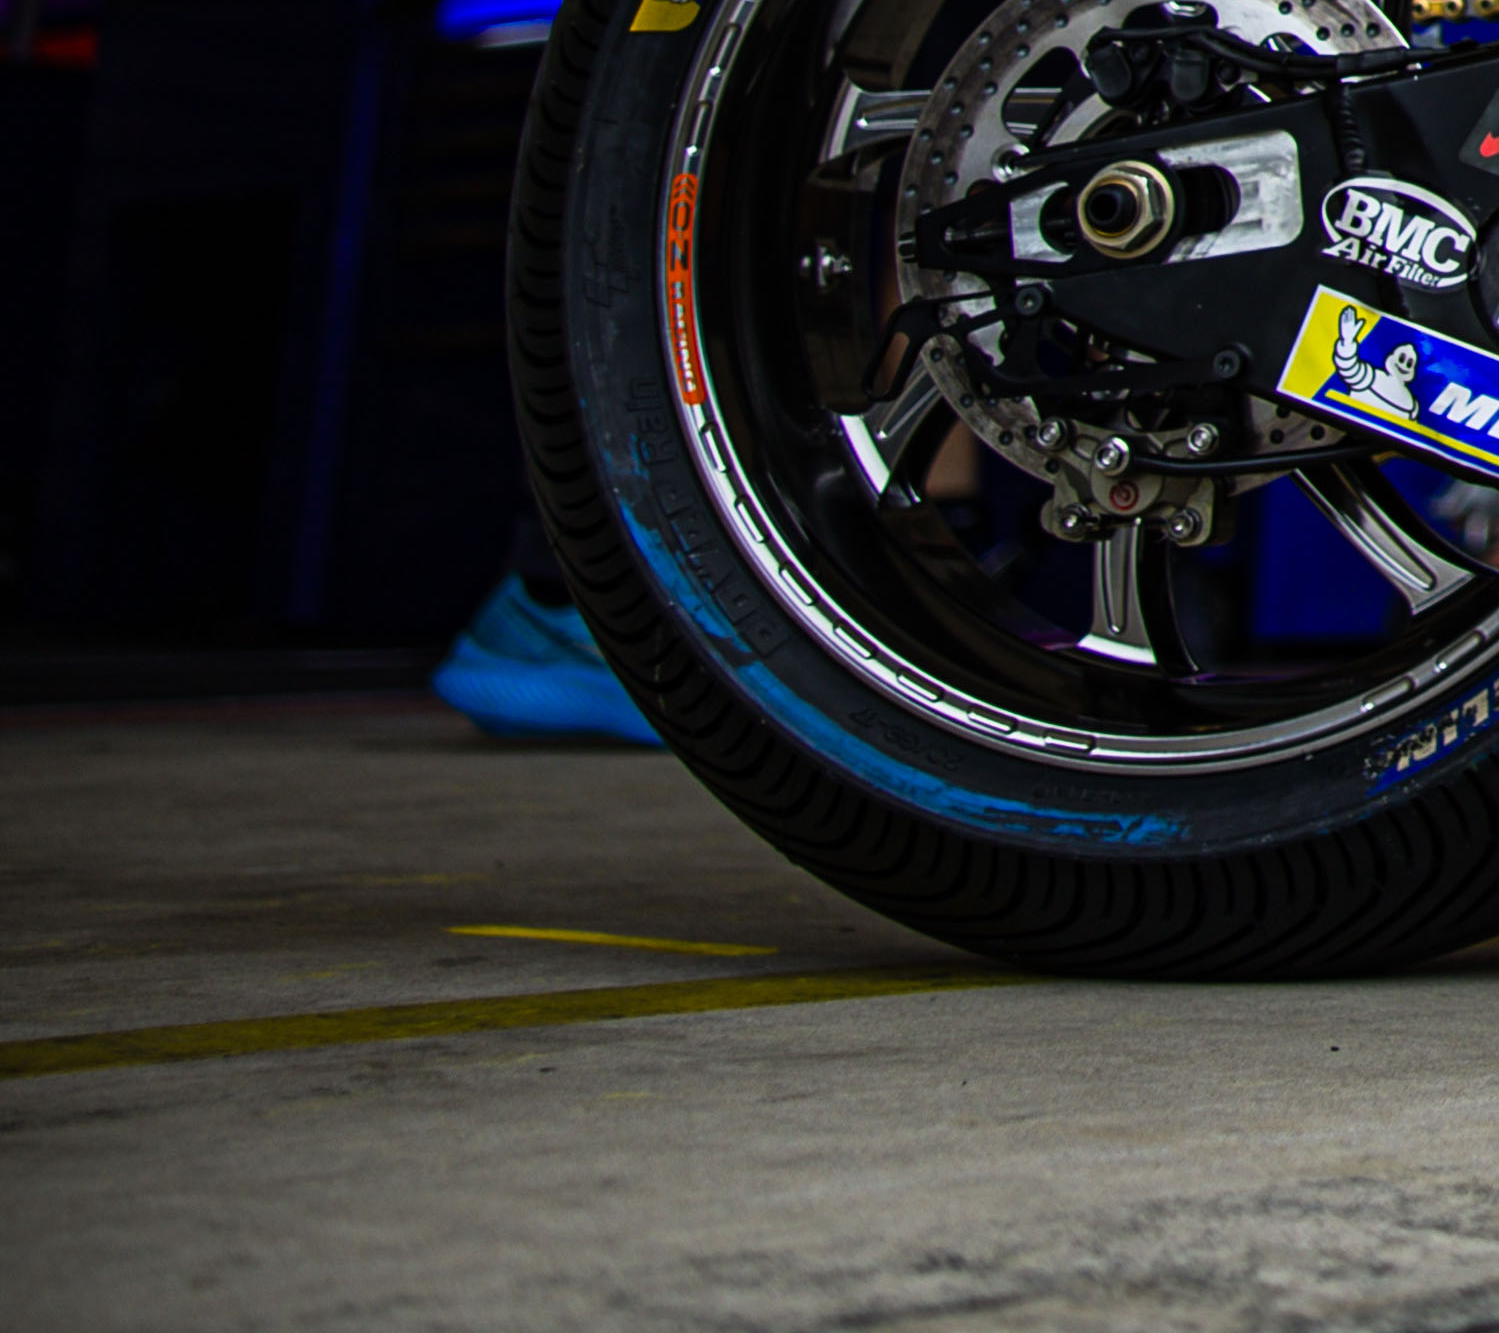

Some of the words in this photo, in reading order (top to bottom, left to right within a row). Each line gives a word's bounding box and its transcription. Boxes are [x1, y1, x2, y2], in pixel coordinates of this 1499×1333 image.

[1322, 237, 1387, 269] Air
[1384, 254, 1441, 287] Filter
[1334, 188, 1470, 273] BMC
